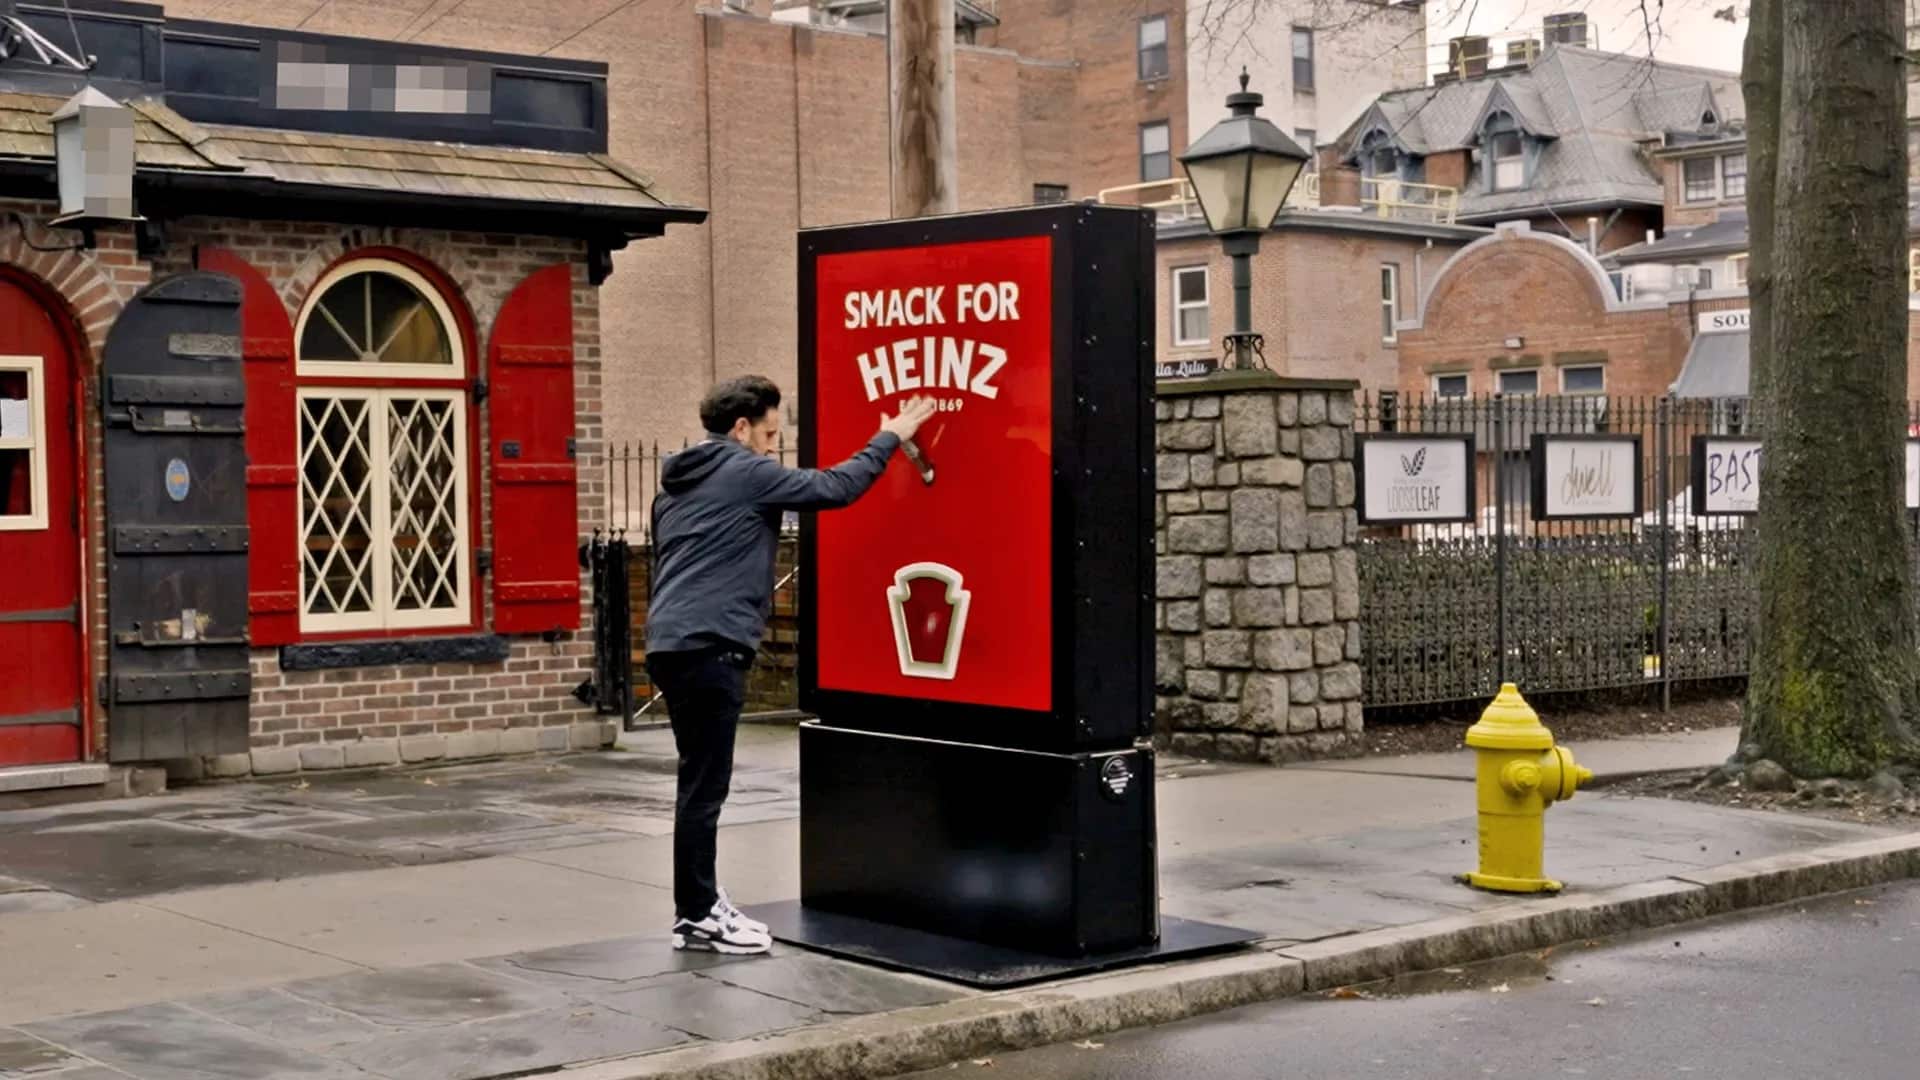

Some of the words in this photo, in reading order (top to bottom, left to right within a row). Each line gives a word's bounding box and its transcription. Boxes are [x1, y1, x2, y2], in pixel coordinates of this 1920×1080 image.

[845, 286, 946, 329] SMACK
[957, 281, 1020, 324] FOR
[856, 336, 1008, 402] HEINZ
[1176, 360, 1208, 378] Lulu
[1386, 485, 1441, 513] LOOSELEAF
[1561, 448, 1616, 506] dwell
